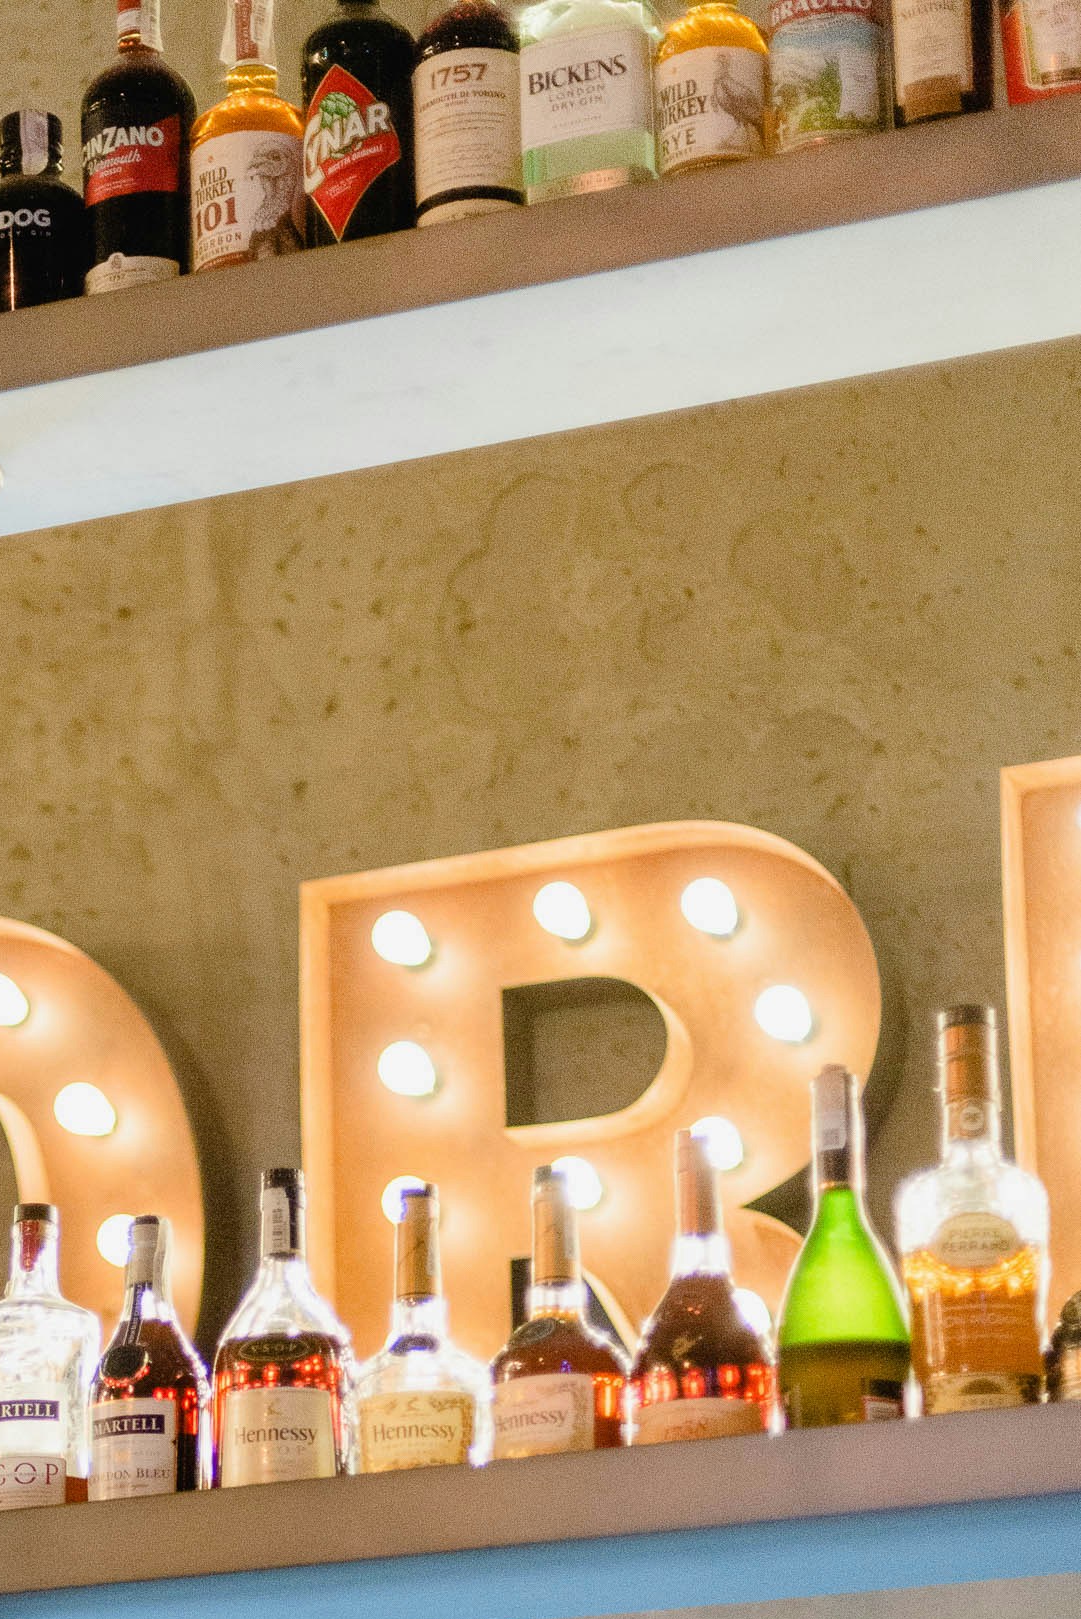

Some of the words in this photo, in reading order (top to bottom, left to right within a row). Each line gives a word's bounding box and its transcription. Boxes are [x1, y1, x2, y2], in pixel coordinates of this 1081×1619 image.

[430, 62, 488, 90] 1757
[528, 54, 627, 95] BICKENS
[549, 83, 606, 103] LONDON
[576, 94, 602, 107] GIN
[659, 79, 697, 108] WILD
[83, 125, 165, 160] INZANO
[303, 102, 390, 194] CYNAR
[662, 127, 696, 158] RYE
[199, 166, 228, 189] WILD
[195, 178, 235, 208] TURKEY
[195, 196, 239, 241] 101
[94, 1416, 161, 1437] MARTELL
[234, 1424, 318, 1446] Hennessy
[372, 1422, 457, 1443] Hennessy
[136, 1467, 171, 1479] BLEU
